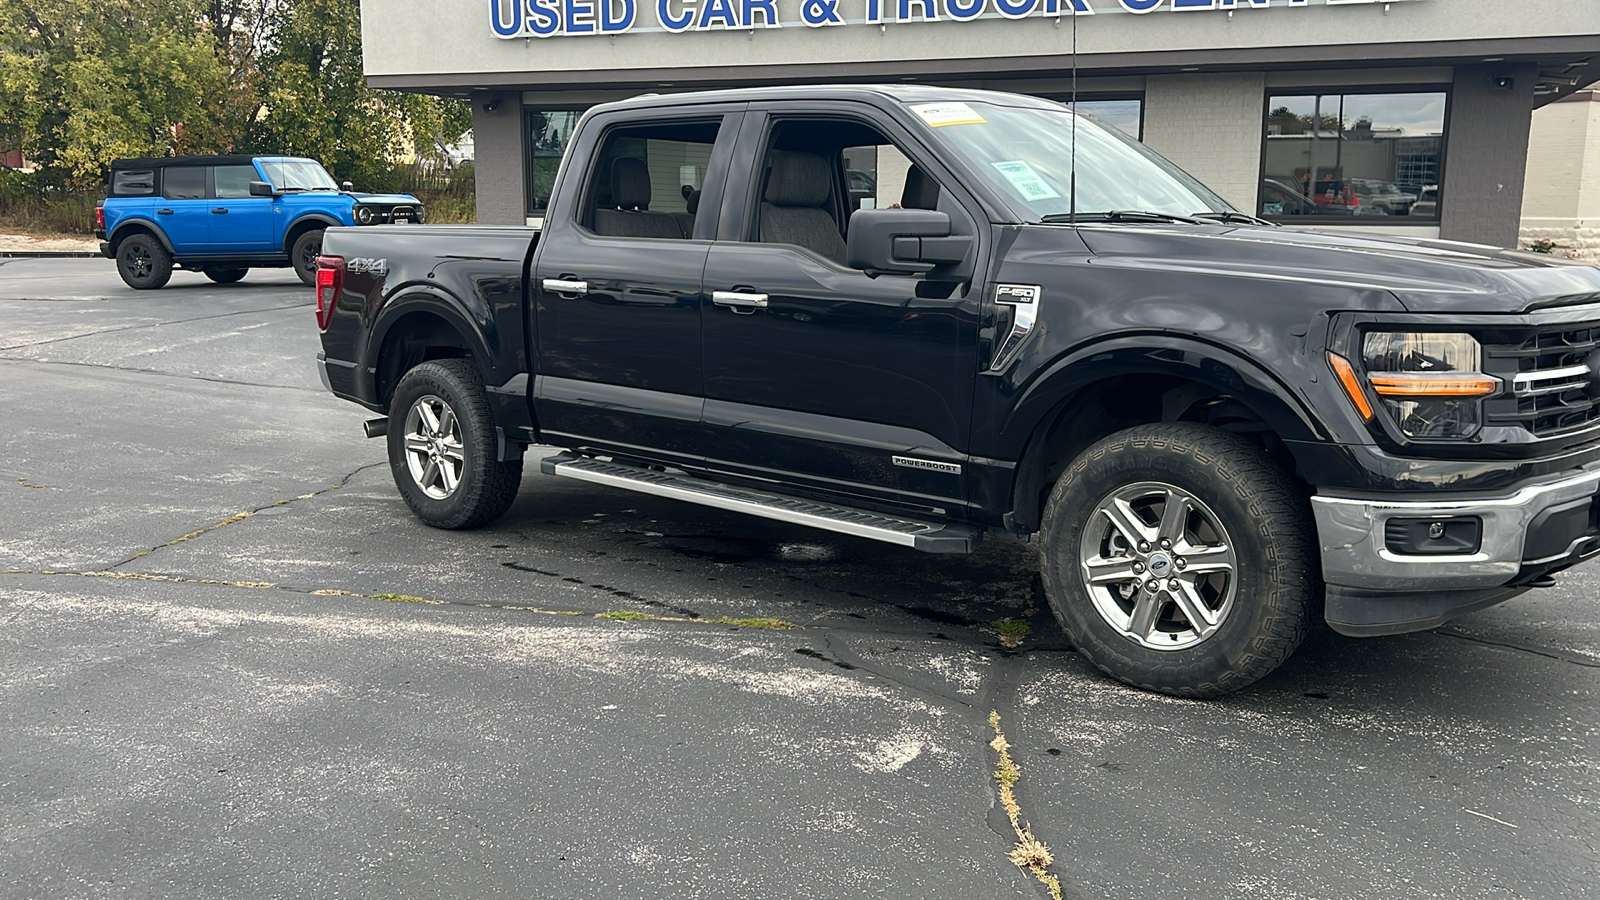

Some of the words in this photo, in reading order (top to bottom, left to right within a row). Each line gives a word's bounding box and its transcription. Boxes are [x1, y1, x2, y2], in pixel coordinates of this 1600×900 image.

[490, 0, 637, 39] USED
[655, 0, 782, 33] CAR
[998, 287, 1034, 297] F-150
[894, 457, 958, 472] POWERBOOST
